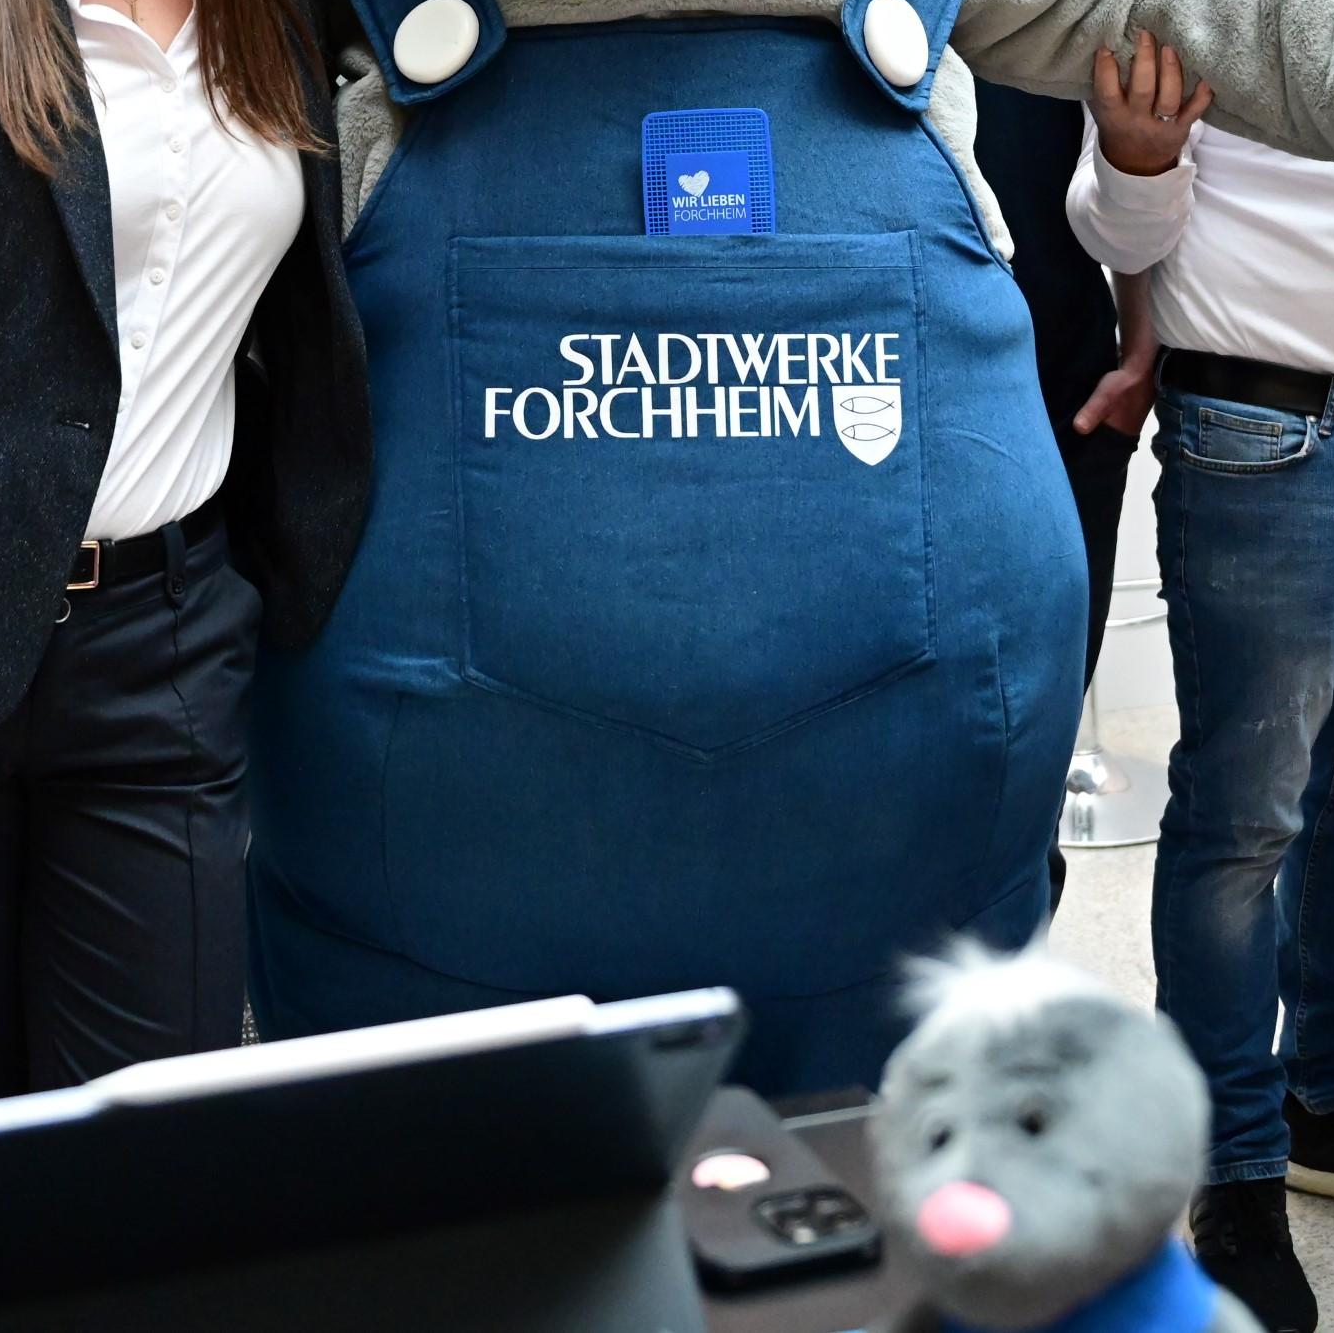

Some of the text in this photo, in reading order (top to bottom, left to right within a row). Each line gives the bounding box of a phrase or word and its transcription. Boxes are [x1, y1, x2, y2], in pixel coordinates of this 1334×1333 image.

[672, 193, 745, 208] WIR LIEBEN
[674, 207, 747, 222] FORCHHEIM
[559, 332, 901, 386] STADTWERKE
[483, 385, 821, 441] FORCHHEIM
